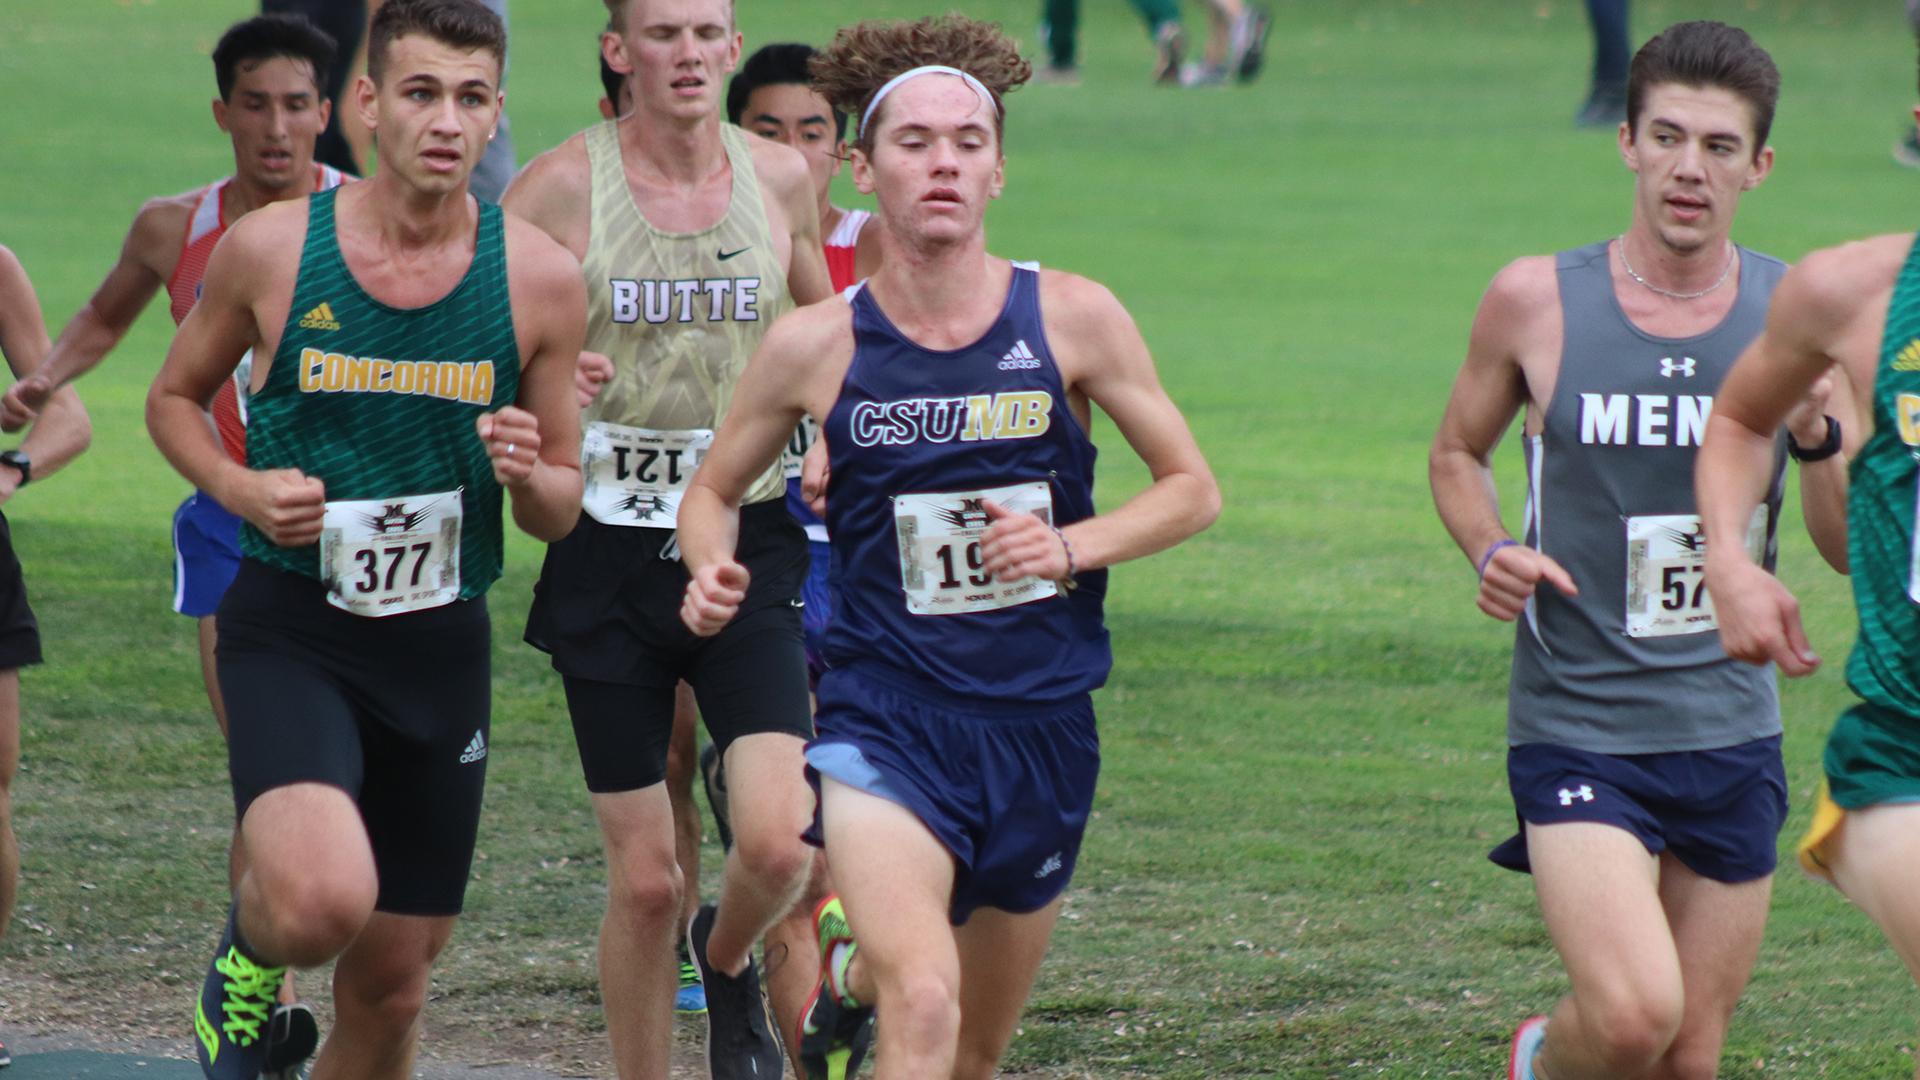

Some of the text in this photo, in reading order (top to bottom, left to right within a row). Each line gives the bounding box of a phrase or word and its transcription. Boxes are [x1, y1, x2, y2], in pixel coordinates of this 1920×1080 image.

[610, 278, 760, 324] BUTTE
[300, 319, 340, 331] adidas
[299, 347, 495, 406] CONCORDIA
[997, 358, 1041, 371] adidas
[850, 390, 1053, 447] CSUMB
[1577, 393, 1713, 446] MEN
[613, 446, 683, 485] 121
[355, 541, 432, 594] 377
[936, 541, 993, 589] 19
[1662, 565, 1706, 611] 57
